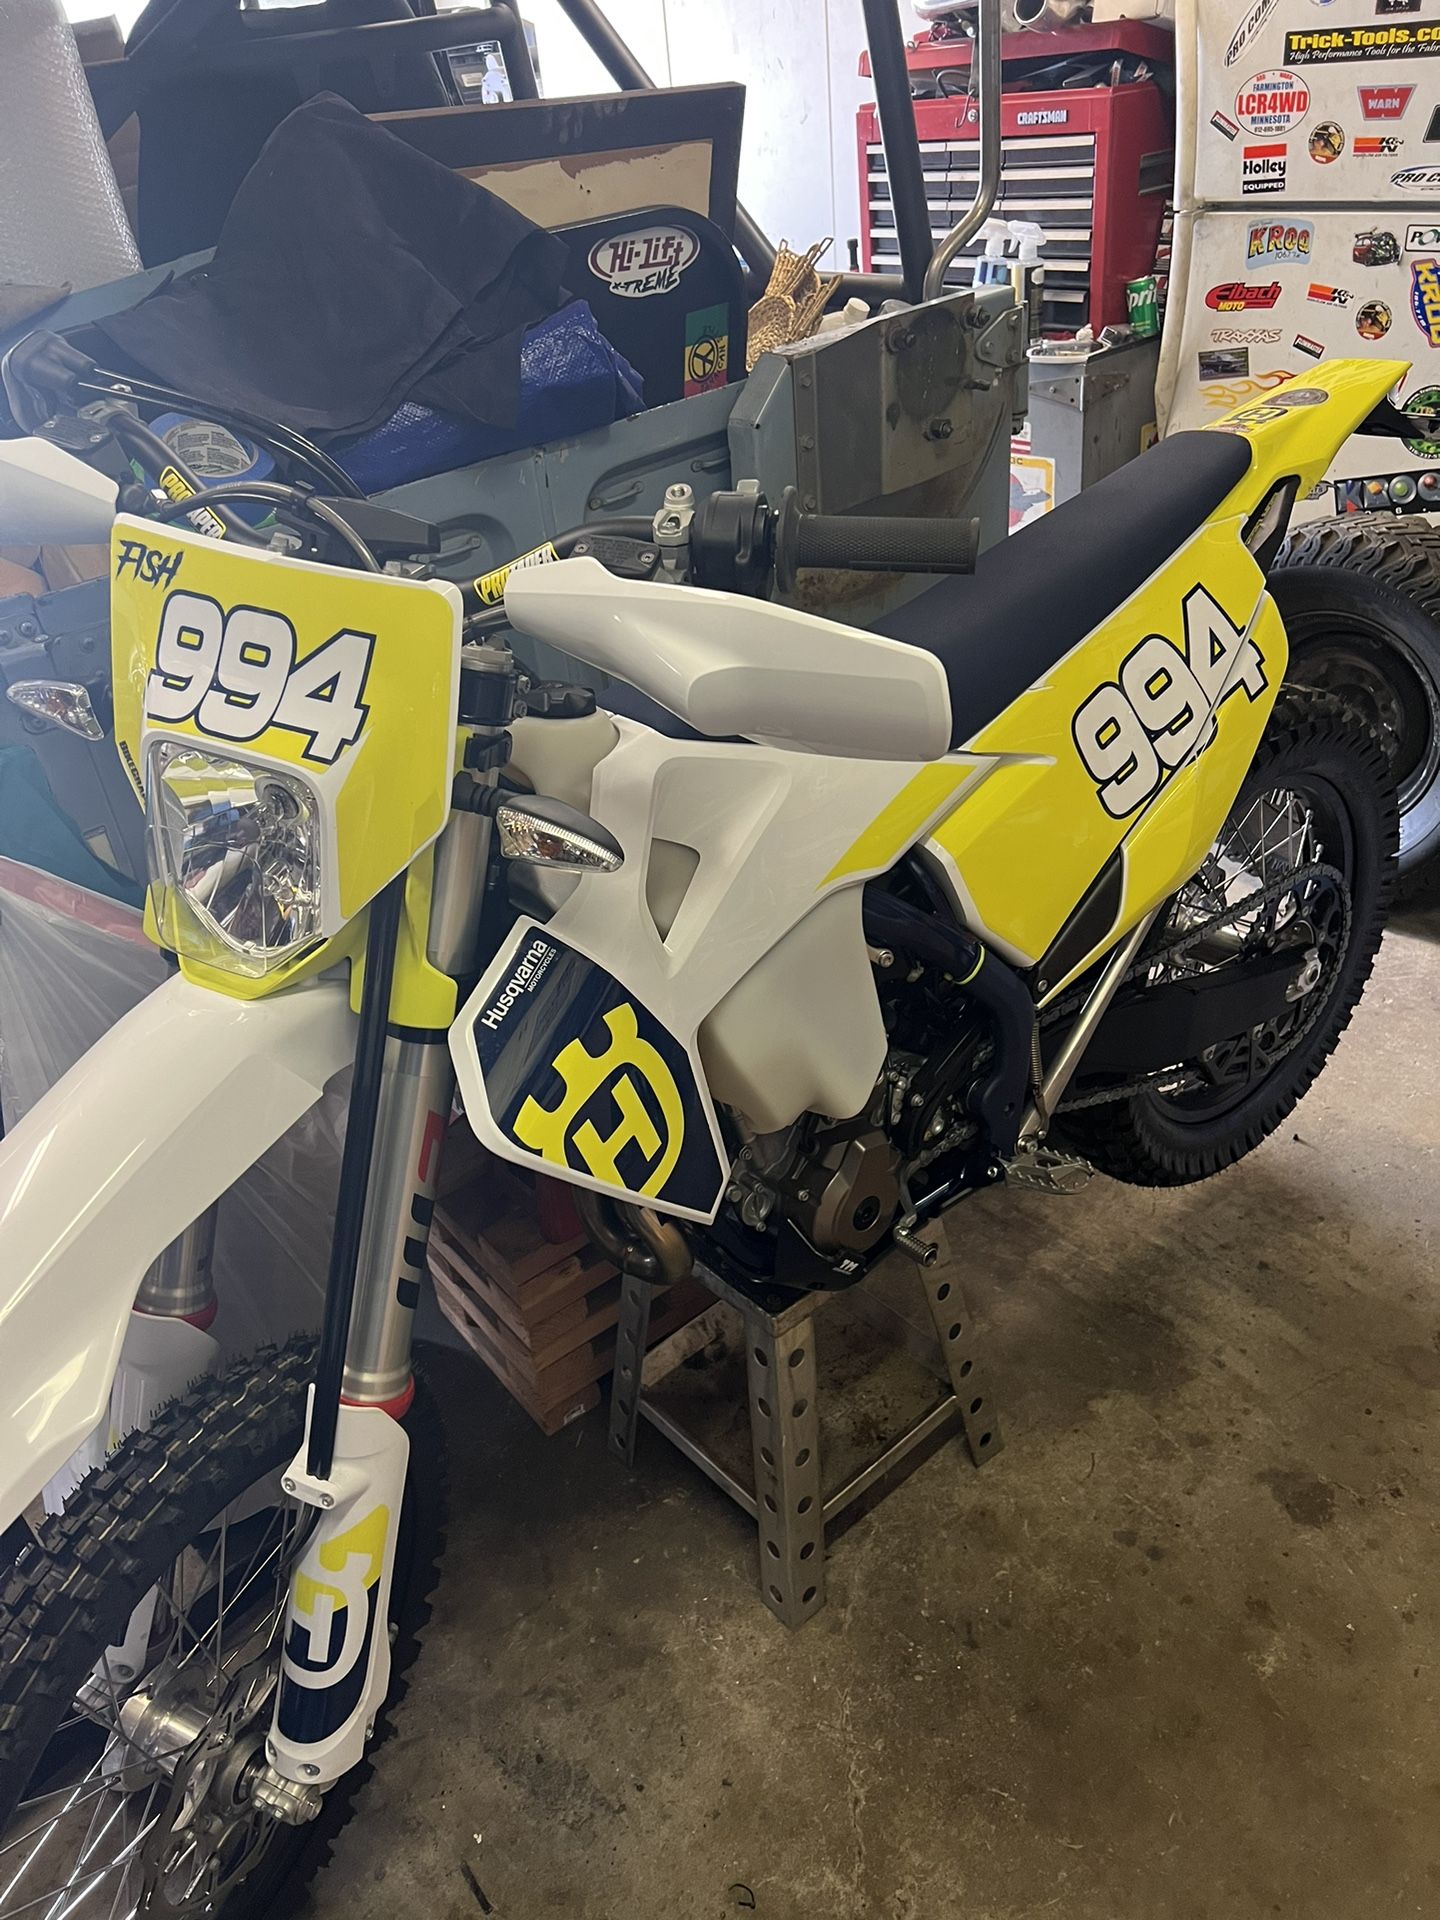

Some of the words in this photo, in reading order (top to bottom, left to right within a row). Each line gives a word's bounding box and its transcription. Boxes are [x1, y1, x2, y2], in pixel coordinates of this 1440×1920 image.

[1226, 30, 1245, 67] PRO
[1290, 49, 1310, 64] High
[1312, 48, 1363, 61] Performance
[1365, 45, 1386, 56] Tools
[1386, 44, 1401, 56] for
[1402, 41, 1416, 54] the
[1252, 81, 1294, 93] FARMINGTON
[1237, 90, 1308, 116] LCR4WD
[1368, 98, 1400, 109] WARN
[1017, 109, 1068, 126] CRAFTSMAN
[1250, 114, 1291, 126] MINNESOTA
[1243, 159, 1286, 177] Holley
[1390, 173, 1427, 183] PRO
[1243, 182, 1285, 191] EQUIPPED
[609, 233, 685, 273] Hi-Lift
[1248, 225, 1311, 259] KROQ
[611, 269, 681, 294] X-TREME
[1217, 301, 1246, 311] MOTO
[1210, 328, 1282, 344] TRAXXAS
[186, 507, 224, 540] APER
[116, 540, 184, 592] FISH
[146, 589, 377, 766] 994
[1071, 581, 1269, 820] 994
[527, 948, 557, 994] MOTORCYCLES
[481, 938, 548, 1030] Husqvarna
